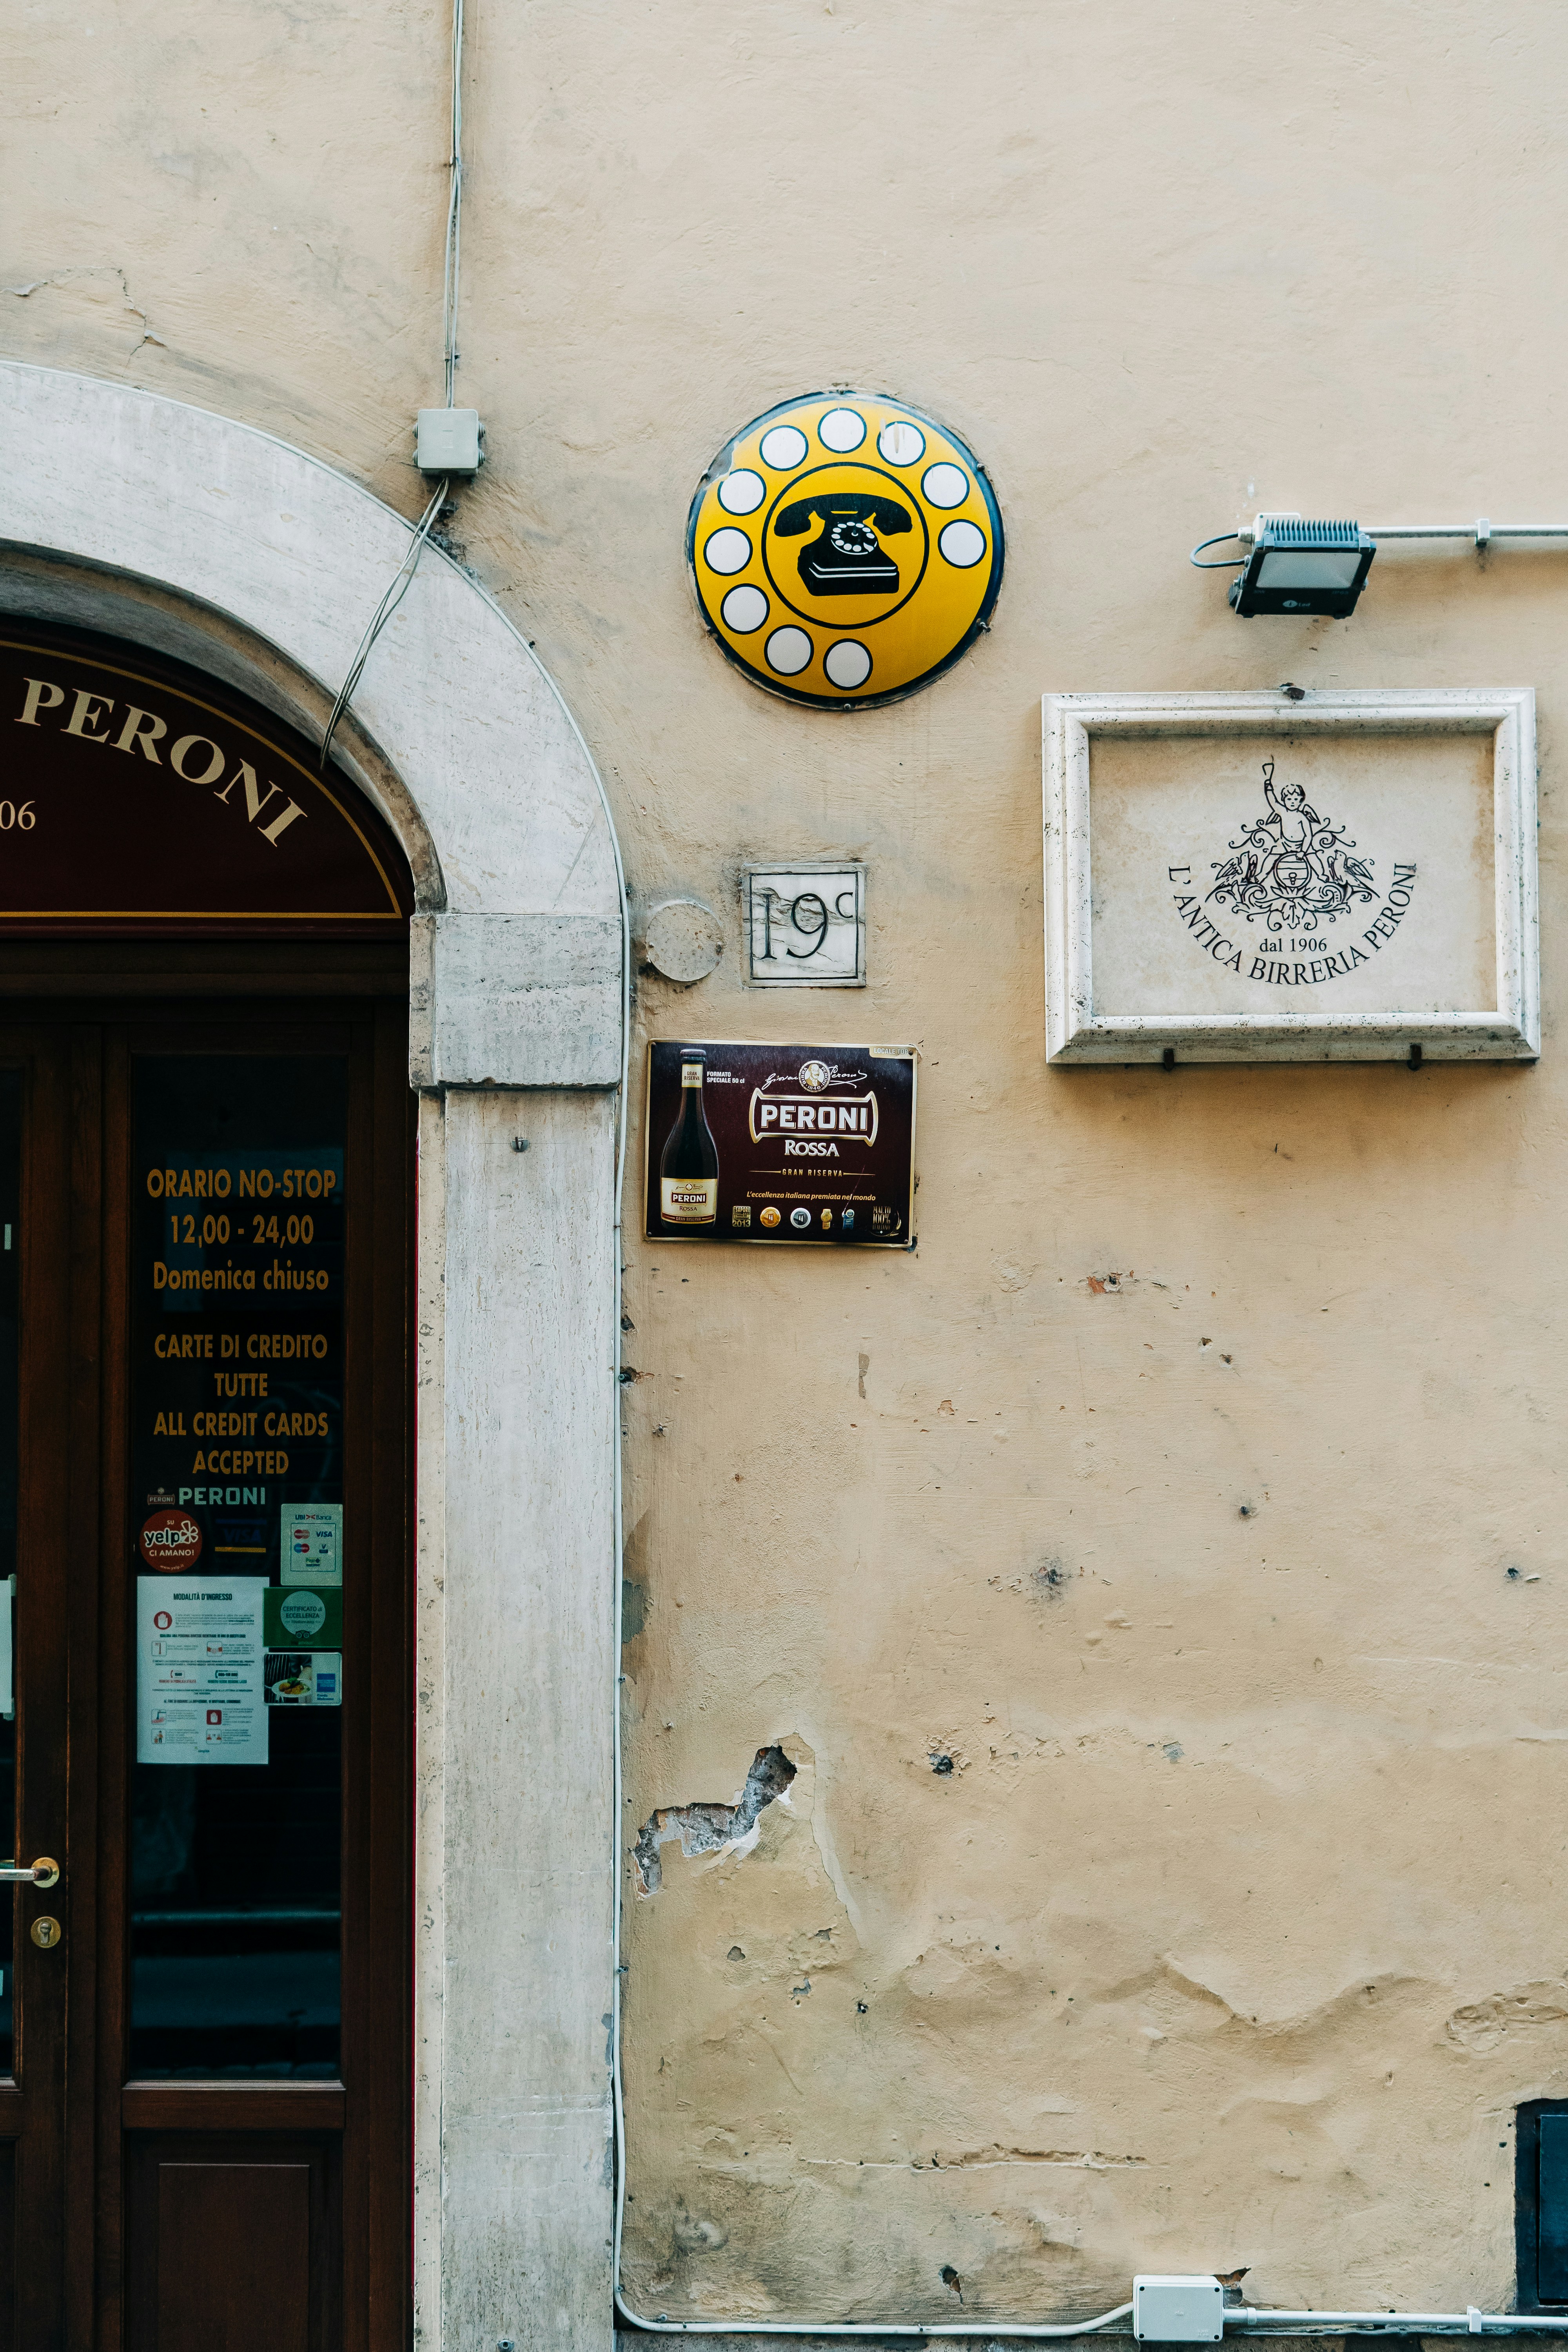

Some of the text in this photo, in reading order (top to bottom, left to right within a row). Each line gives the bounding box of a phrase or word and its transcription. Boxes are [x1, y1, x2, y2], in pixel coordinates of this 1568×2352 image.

[14, 677, 308, 847] PERONI
[1247, 945, 1370, 985] BIRRERIA
[1362, 863, 1416, 952] PERONI
[1259, 938, 1328, 952] dal 1906
[761, 1105, 868, 1131] PERONI
[784, 1140, 840, 1157] ROSSA
[147, 1169, 336, 1198] ORARIO NO-STOP
[873, 1213, 890, 1224] 100%
[171, 1214, 230, 1248] 12,00
[253, 1214, 314, 1248] 24,00
[154, 1259, 329, 1290] Domenica chiuso
[154, 1334, 328, 1359] CARTE DI CREDITO
[214, 1373, 268, 1397] TUTTE
[154, 1412, 328, 1437] ALL CREDIT CARDS
[192, 1450, 289, 1474] ACCEPTED
[179, 1487, 266, 1505] PERONI
[144, 1528, 180, 1546] yelp
[222, 1528, 262, 1543] VISA
[173, 1592, 200, 1601] MODALITÀ
